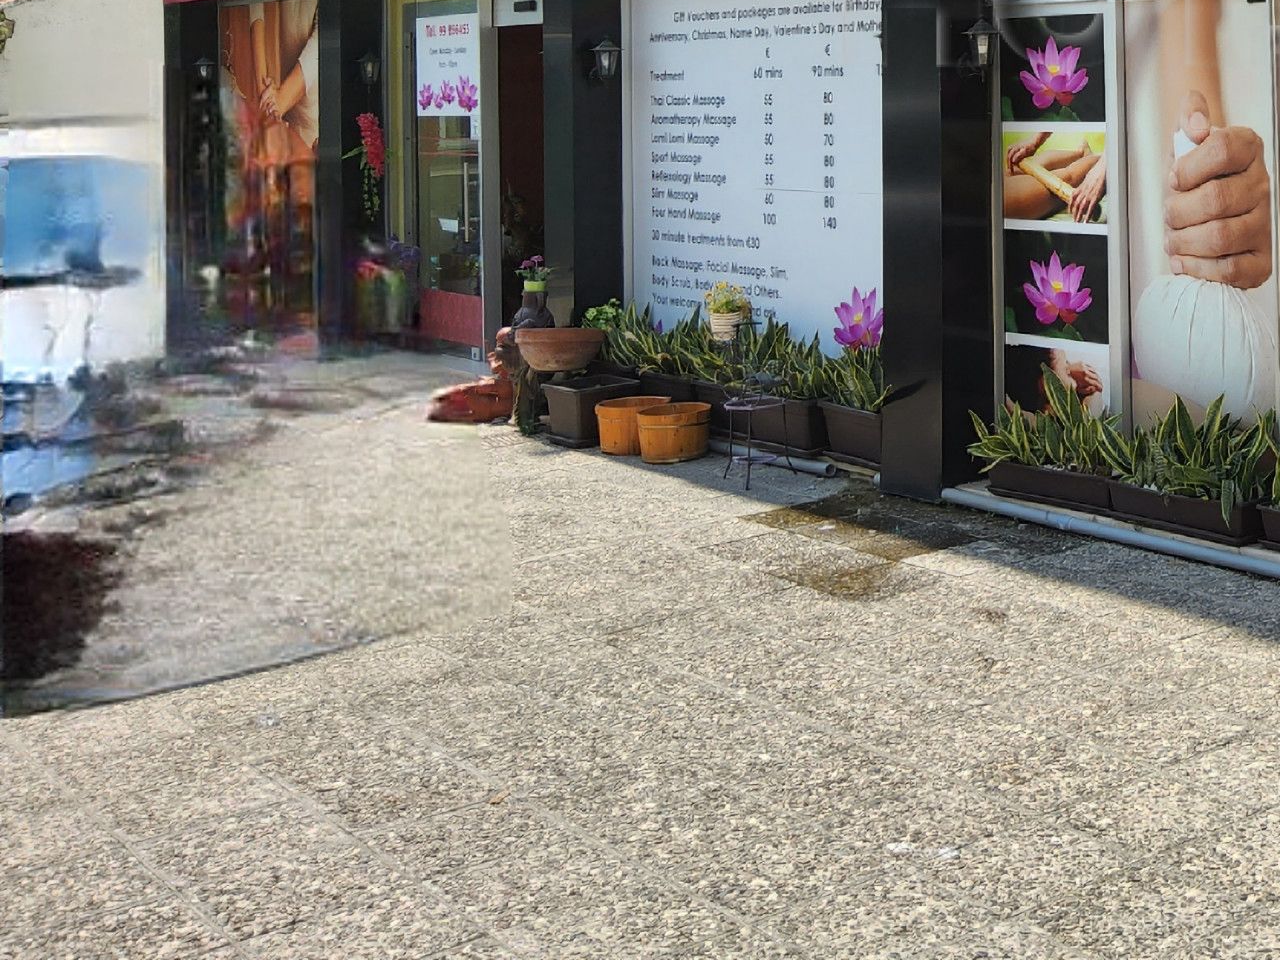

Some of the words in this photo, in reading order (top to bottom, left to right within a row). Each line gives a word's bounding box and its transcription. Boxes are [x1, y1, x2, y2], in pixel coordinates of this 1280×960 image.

[722, 7, 737, 19] and
[738, 5, 776, 21] packages
[793, 1, 831, 15] available
[833, 0, 843, 12] for
[730, 27, 753, 39] Name
[819, 22, 834, 35] Day
[838, 22, 854, 33] and
[753, 66, 762, 78] 60
[765, 66, 783, 78] mins
[812, 65, 822, 77] 90
[824, 64, 844, 76] mins
[693, 94, 725, 109] Massage
[703, 113, 737, 127] Massage
[688, 132, 720, 147] Massage
[824, 134, 834, 146] 70
[670, 152, 702, 165] Massage
[824, 155, 834, 167] 80
[693, 172, 726, 186] Massage
[824, 176, 835, 189] 80
[667, 189, 699, 203] Massage
[824, 196, 835, 208] 80
[668, 207, 687, 220] Hand
[688, 208, 721, 224] Massage
[763, 213, 776, 225] 100
[823, 217, 837, 229] 140
